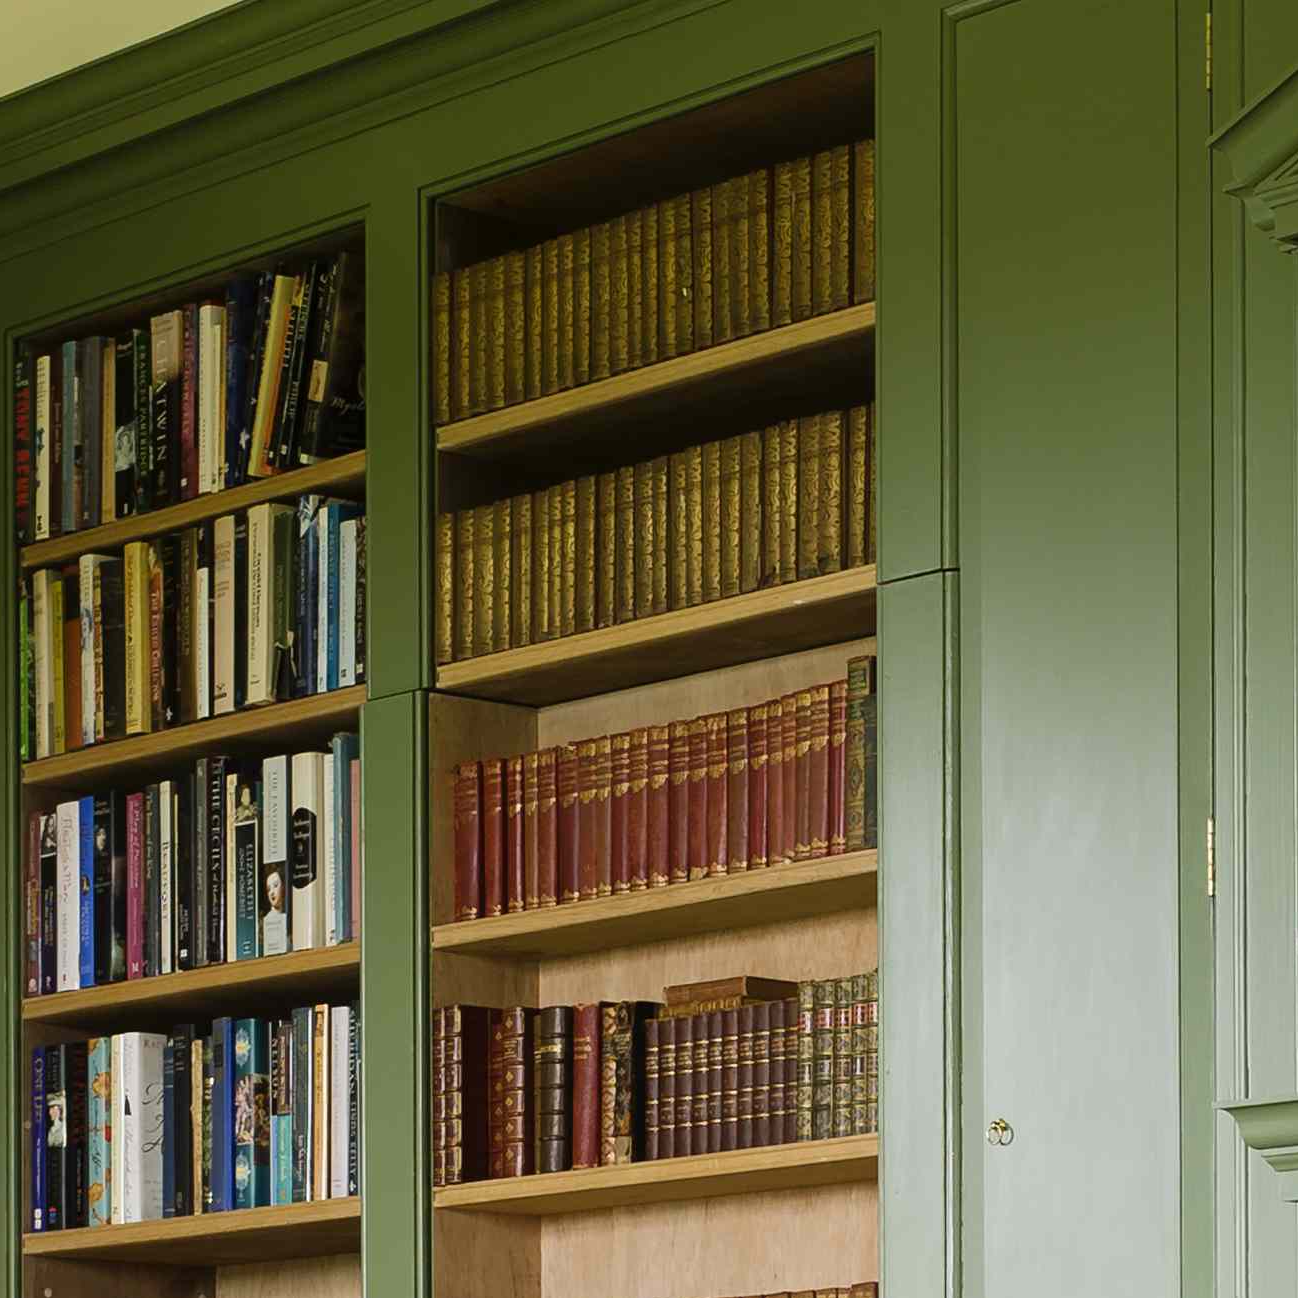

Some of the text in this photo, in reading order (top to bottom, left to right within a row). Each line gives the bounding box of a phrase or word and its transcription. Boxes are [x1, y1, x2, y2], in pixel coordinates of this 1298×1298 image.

[139, 408, 148, 477] PARTRIDGE
[156, 338, 168, 461] CHATWIN
[212, 777, 222, 872] THE CECILS
